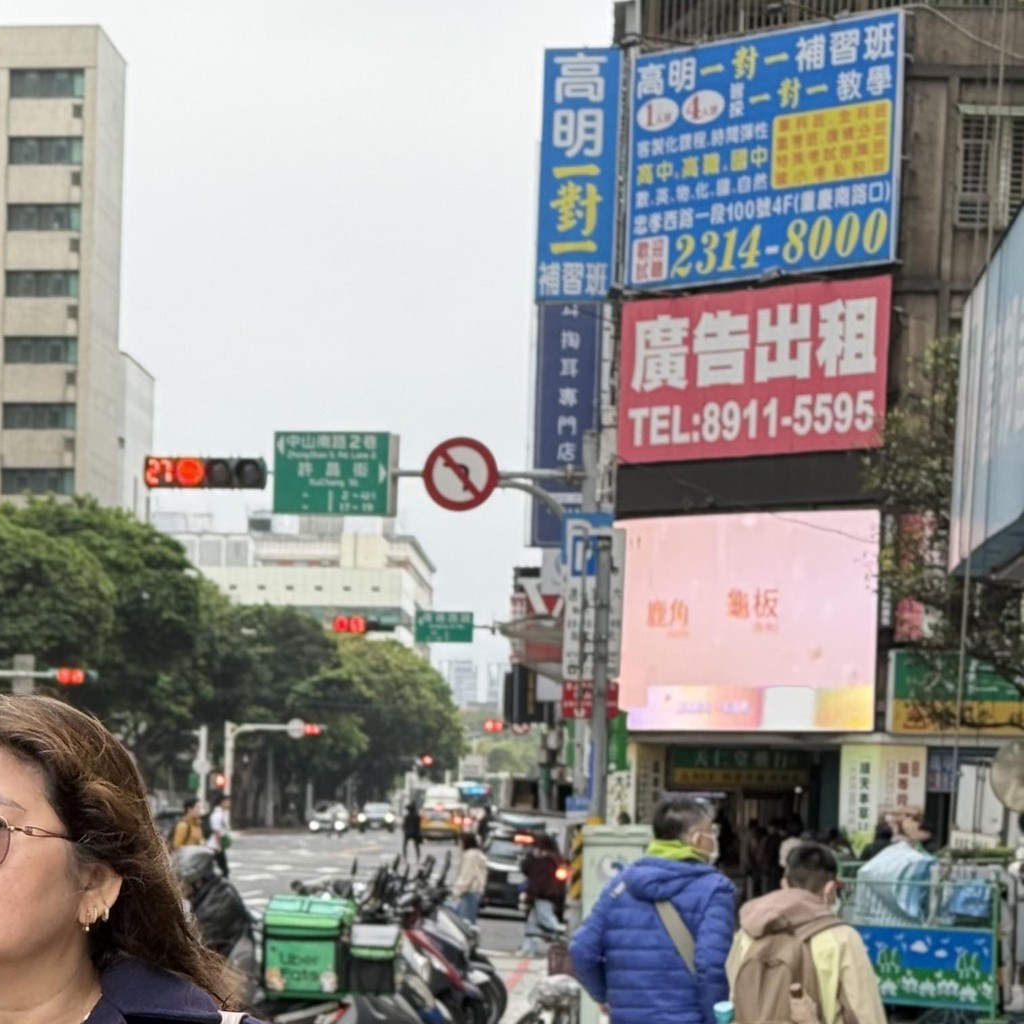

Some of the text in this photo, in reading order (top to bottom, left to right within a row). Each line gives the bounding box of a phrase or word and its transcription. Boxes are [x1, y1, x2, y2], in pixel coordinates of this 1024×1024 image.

[636, 21, 896, 99] 高明一對一補習班
[749, 64, 893, 109] 一對一教學
[549, 52, 608, 255] 高明一對一
[670, 207, 888, 279] 2314-8000
[538, 261, 608, 297] 補習班
[630, 296, 878, 393] 廣告出租
[628, 390, 875, 448] TEL:8911-5595
[279, 952, 320, 966] Uber
